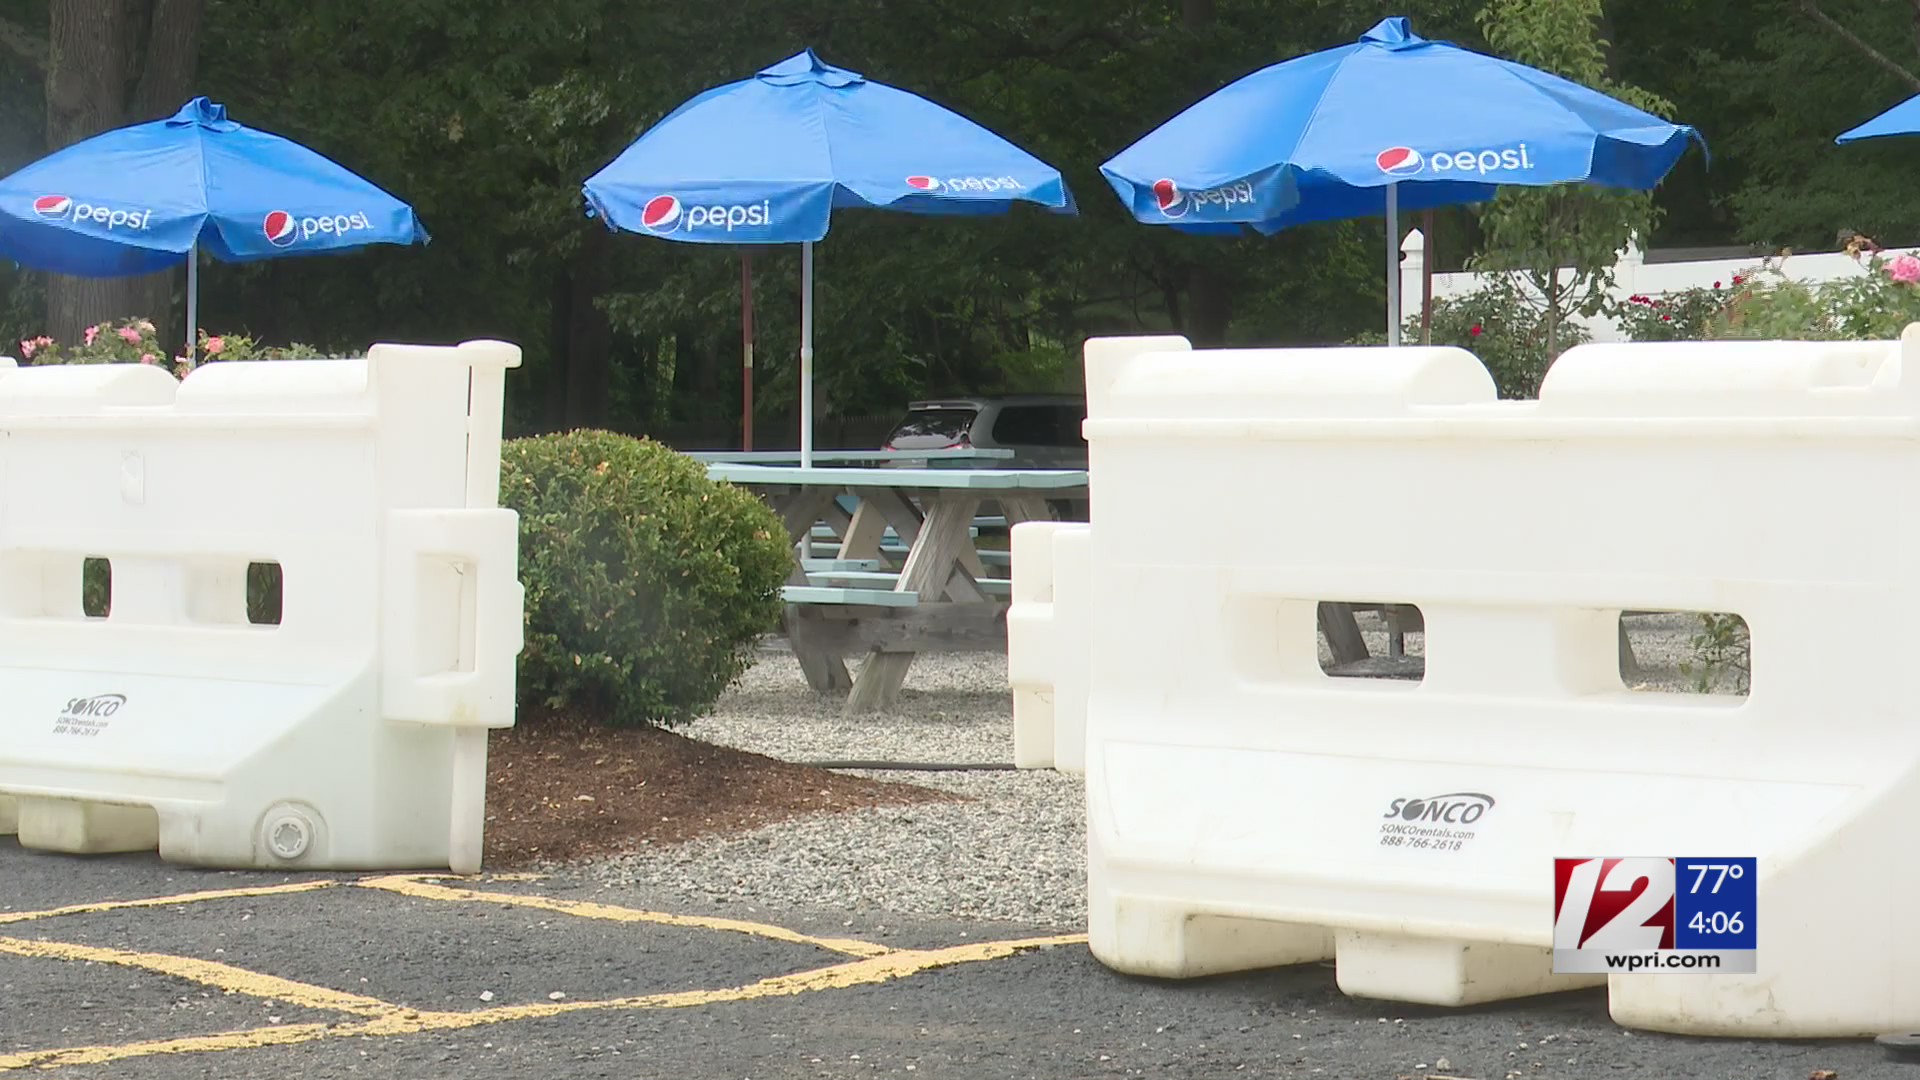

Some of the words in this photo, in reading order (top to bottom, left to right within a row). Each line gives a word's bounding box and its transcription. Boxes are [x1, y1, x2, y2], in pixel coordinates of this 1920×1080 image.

[1431, 143, 1534, 175] pepsi
[945, 175, 1027, 193] pepsi
[1188, 181, 1256, 213] pepsi
[72, 202, 152, 232] pepsi
[302, 211, 374, 240] pepsi
[687, 199, 772, 232] pepsi
[61, 697, 120, 717] SONCO
[1383, 798, 1485, 824] SONCO
[1380, 823, 1475, 840] SONCOrentals.com
[1380, 834, 1463, 852] 888-766-2618
